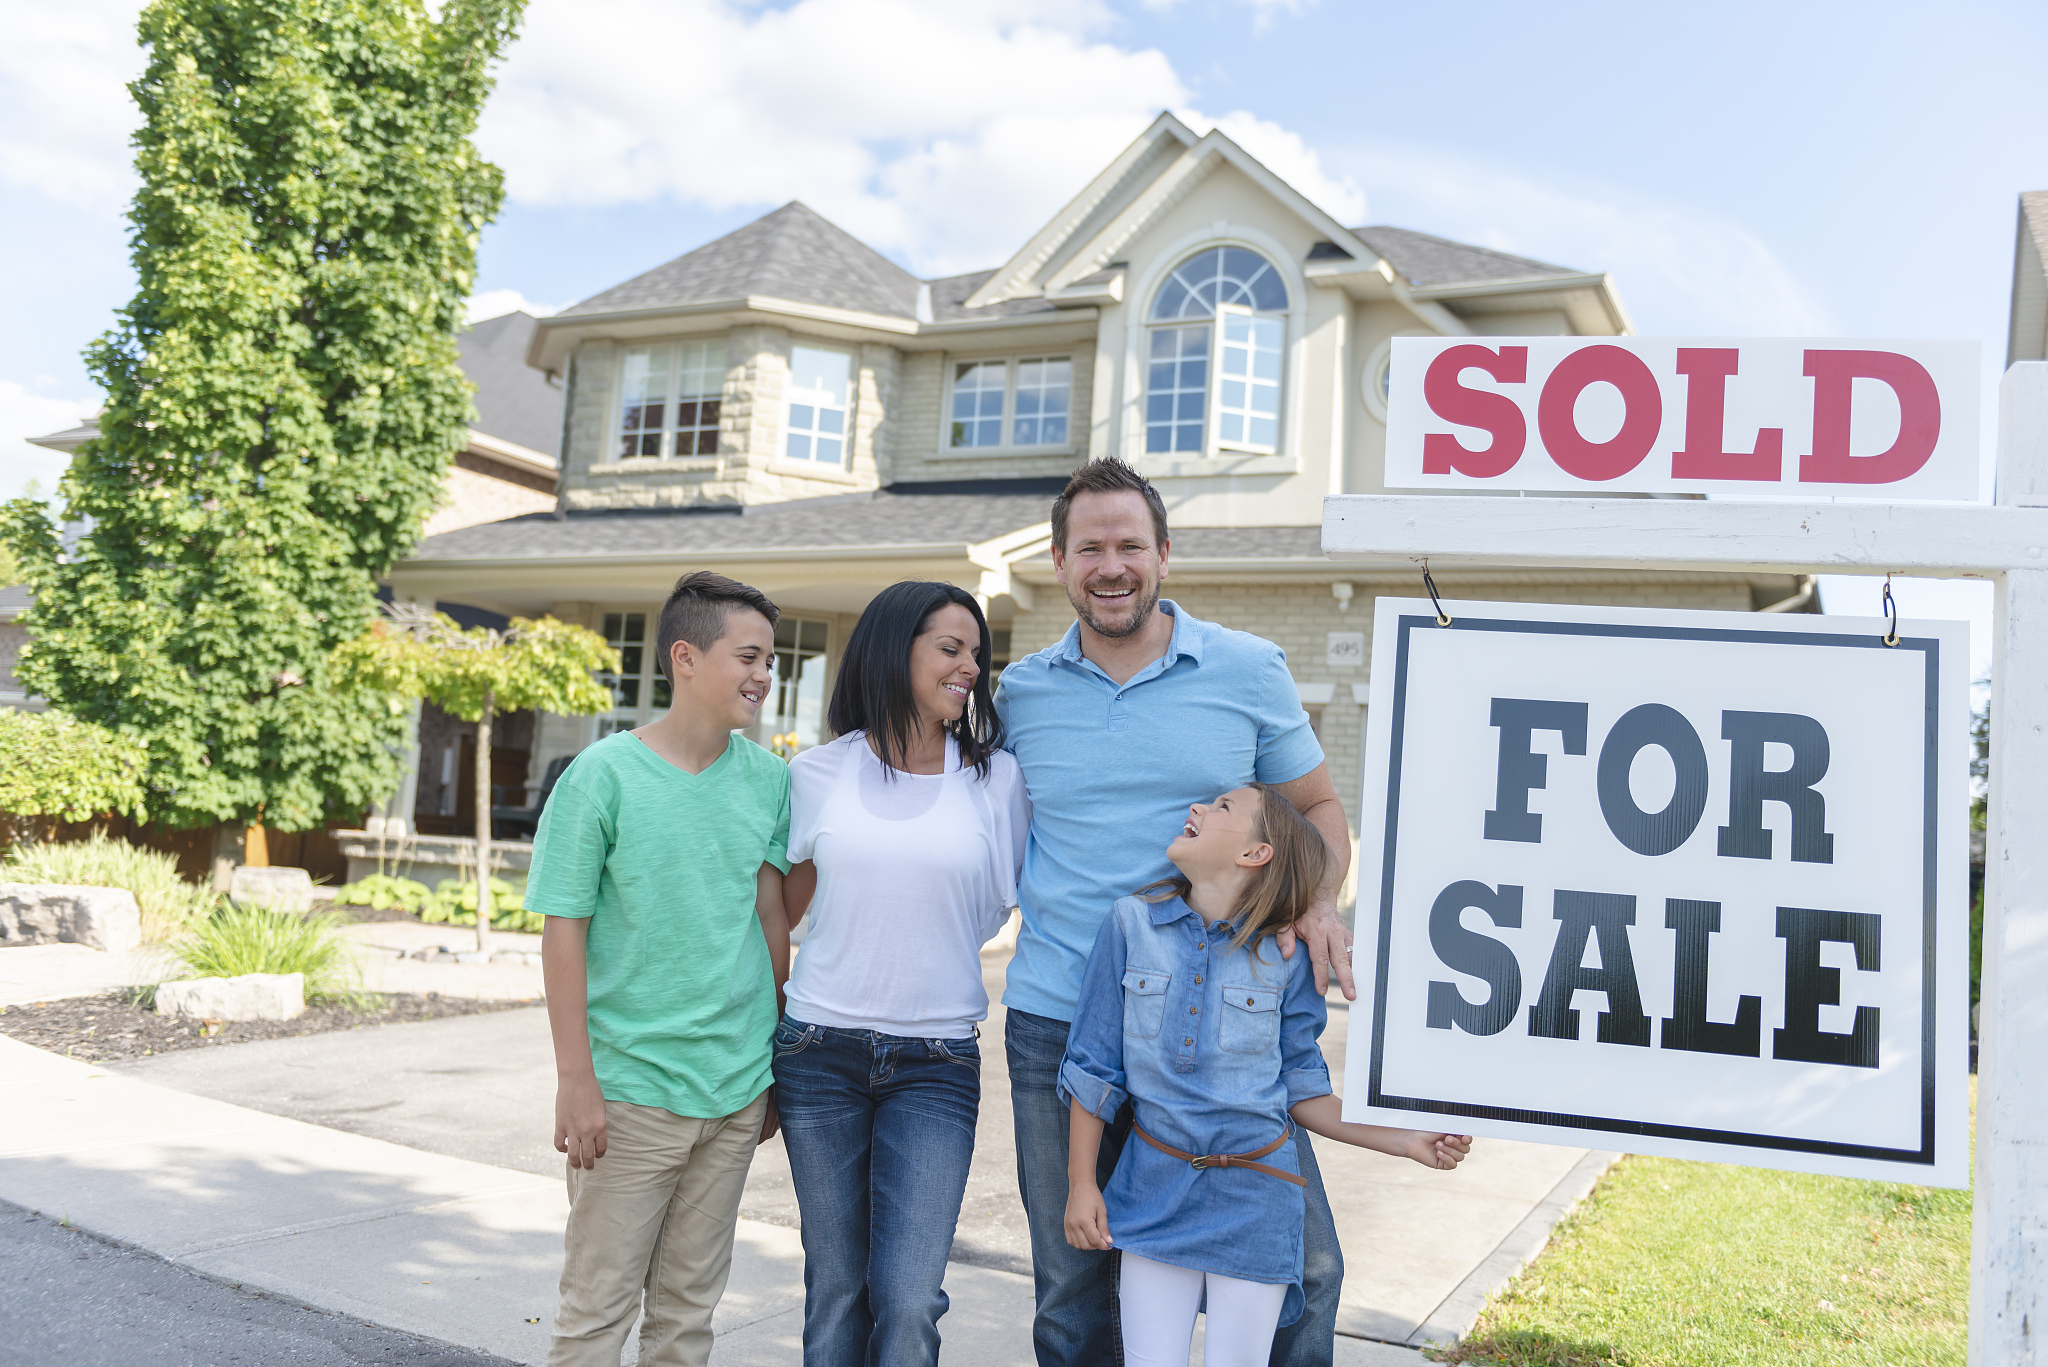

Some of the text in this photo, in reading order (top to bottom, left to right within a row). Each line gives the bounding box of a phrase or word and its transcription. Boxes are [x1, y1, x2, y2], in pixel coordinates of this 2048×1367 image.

[1423, 345, 1941, 484] SOLD
[1331, 641, 1359, 657] 495
[1484, 698, 1834, 864] FOR
[1426, 880, 1882, 1069] SALE
